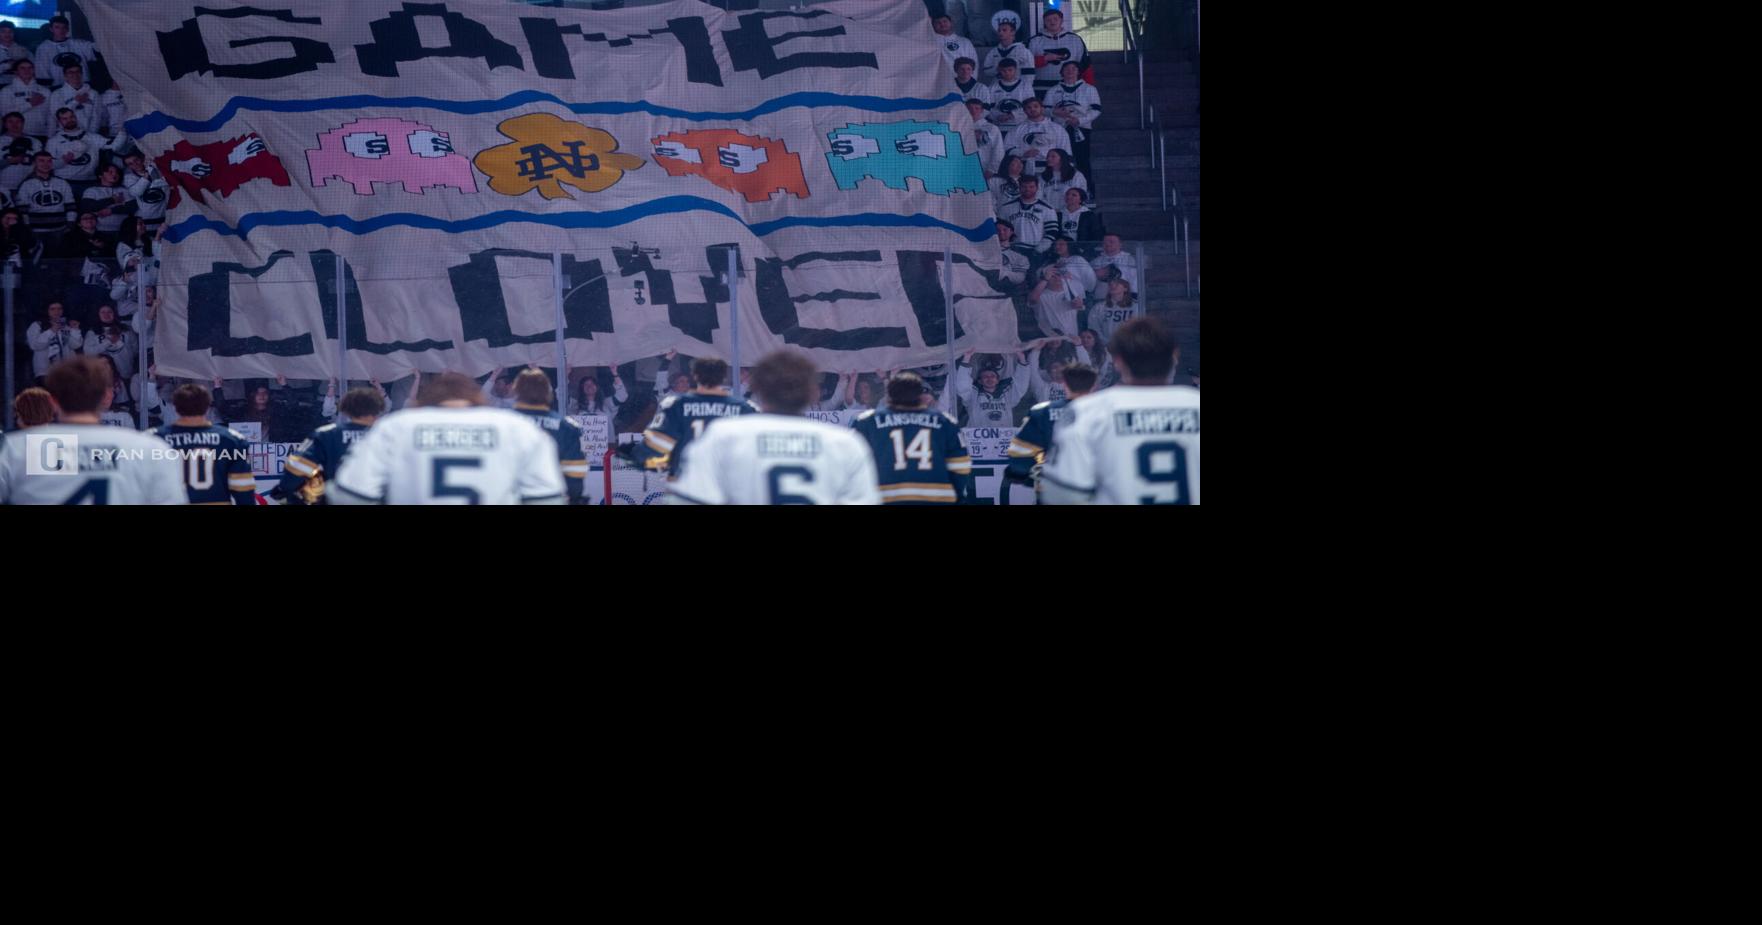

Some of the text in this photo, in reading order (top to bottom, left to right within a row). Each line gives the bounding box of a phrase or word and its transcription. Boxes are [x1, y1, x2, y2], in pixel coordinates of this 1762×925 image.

[156, 3, 879, 87] GAME
[365, 139, 389, 154] S
[431, 137, 454, 152] S
[831, 140, 854, 155] S
[896, 140, 920, 154] S
[719, 150, 741, 167] S
[1103, 310, 1134, 322] PSU
[683, 403, 741, 417] PRIMEAU
[874, 412, 943, 429] LANSDELL
[165, 432, 220, 446] STRAND
[889, 428, 933, 470] 14
[430, 455, 483, 506] 5
[1136, 440, 1191, 506] 9
[766, 464, 817, 506] 6
